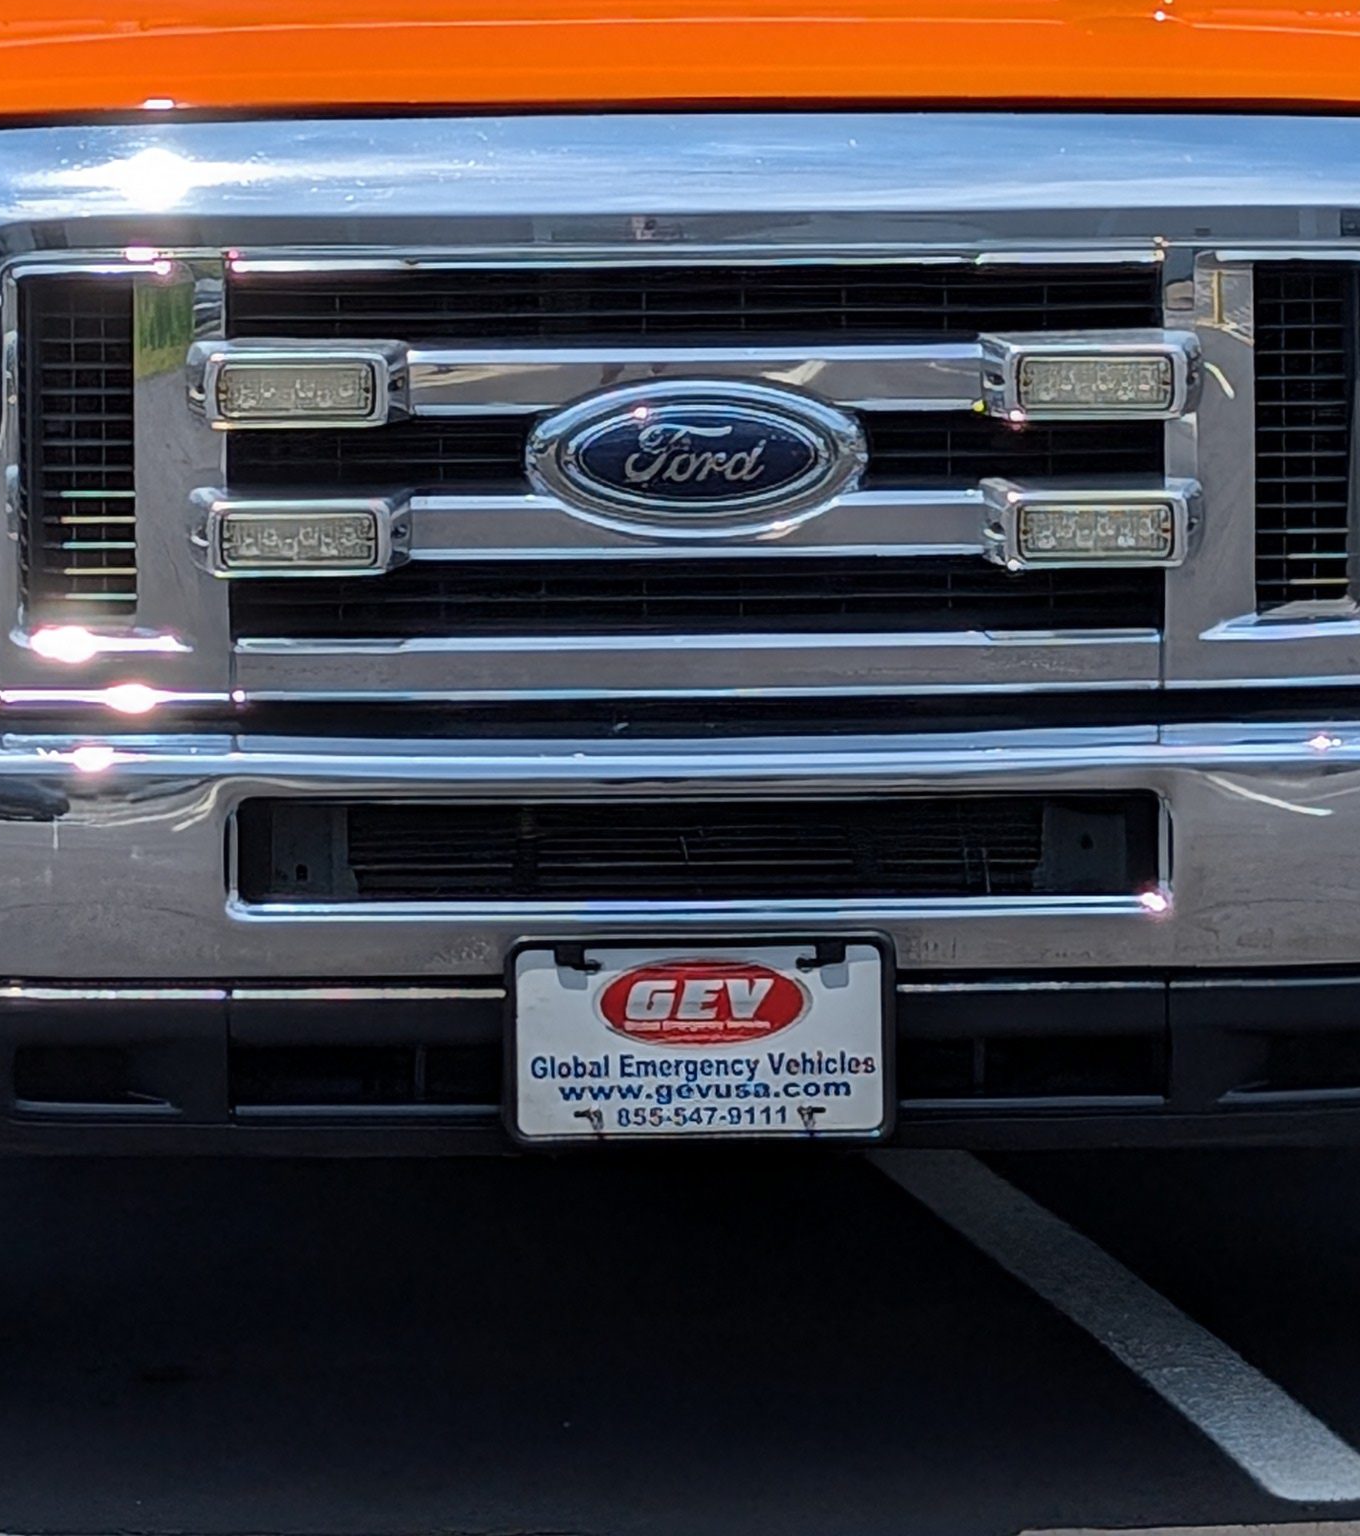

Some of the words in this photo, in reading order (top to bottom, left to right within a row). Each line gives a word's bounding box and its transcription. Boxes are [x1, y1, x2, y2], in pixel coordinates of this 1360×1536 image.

[624, 423, 767, 483] Ford
[625, 978, 775, 1020] GEV
[530, 1054, 610, 1080] Global
[619, 1053, 760, 1082] Emergency
[767, 1050, 877, 1076] Vehicles
[558, 1080, 852, 1105] www.gevusa.com
